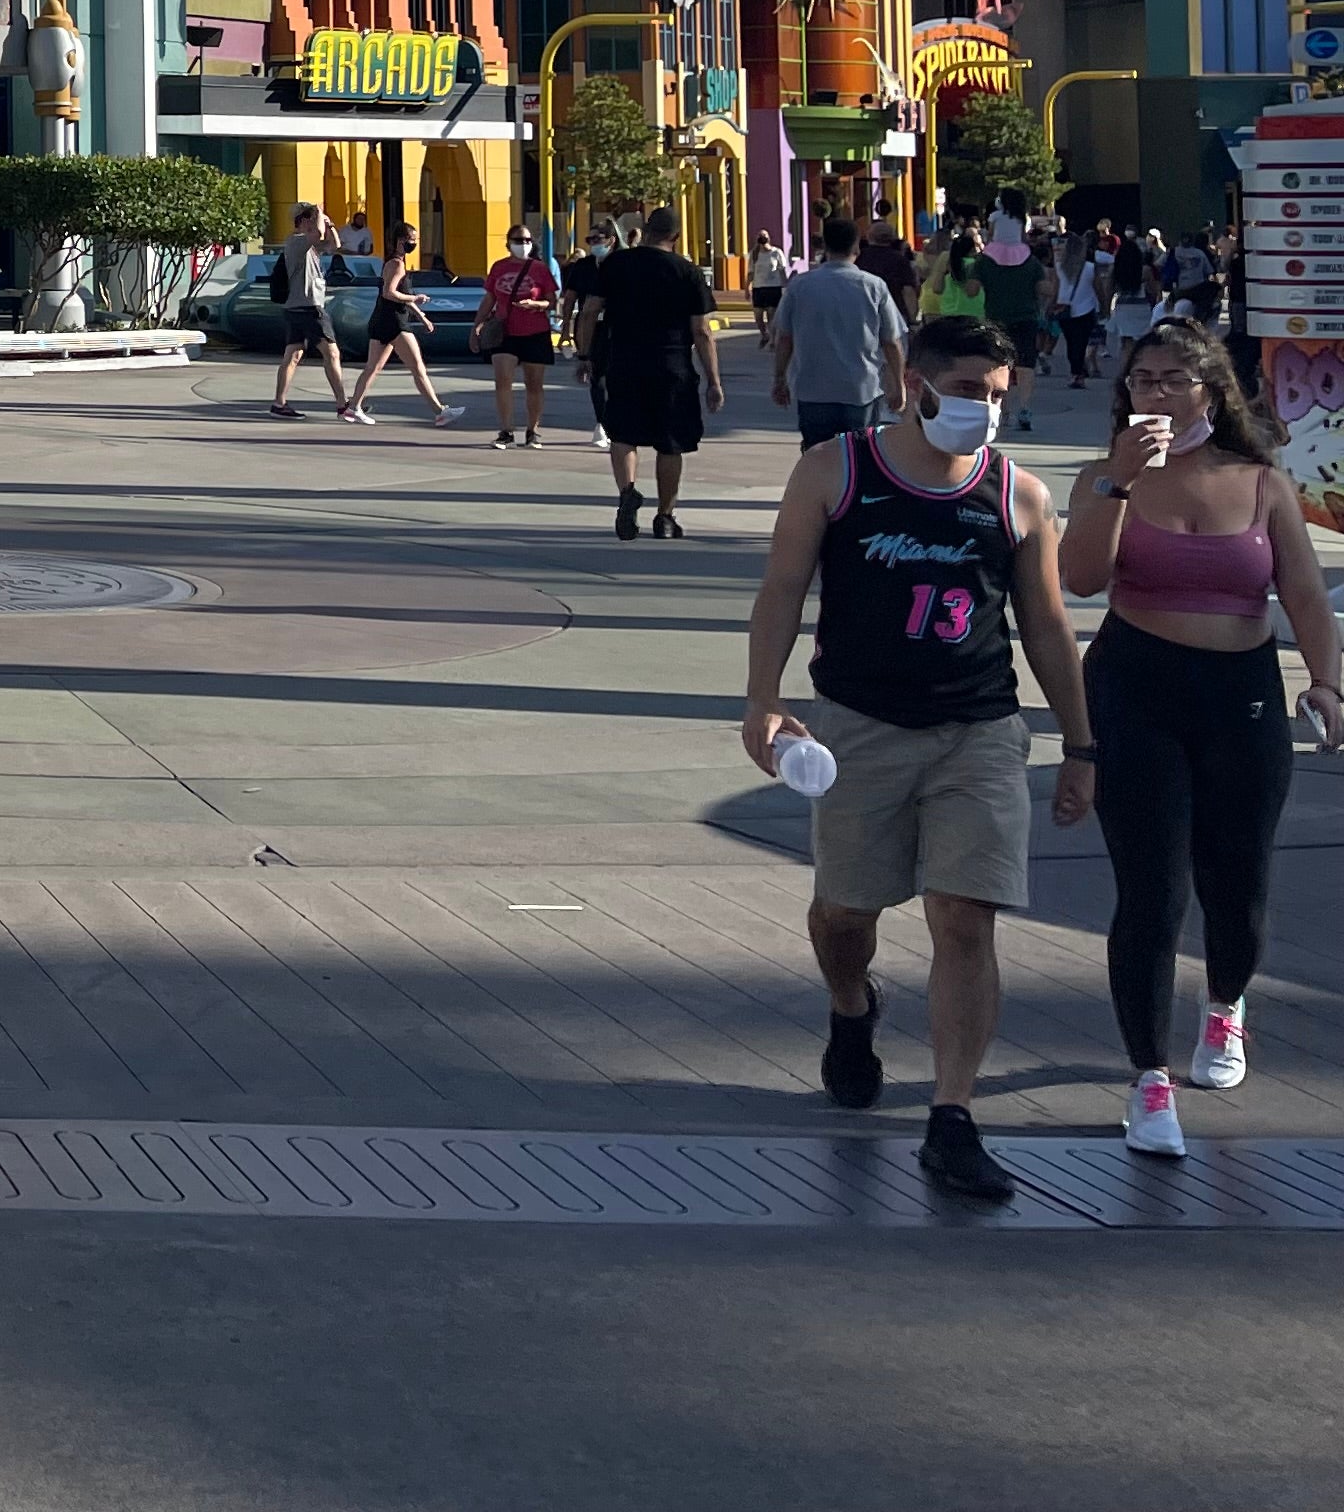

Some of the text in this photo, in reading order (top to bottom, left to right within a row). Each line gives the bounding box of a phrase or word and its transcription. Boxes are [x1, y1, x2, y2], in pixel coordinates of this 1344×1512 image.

[308, 34, 456, 97] ARCADE
[707, 68, 739, 114] SHOP
[858, 532, 982, 569] Miami
[905, 584, 975, 644] 13
